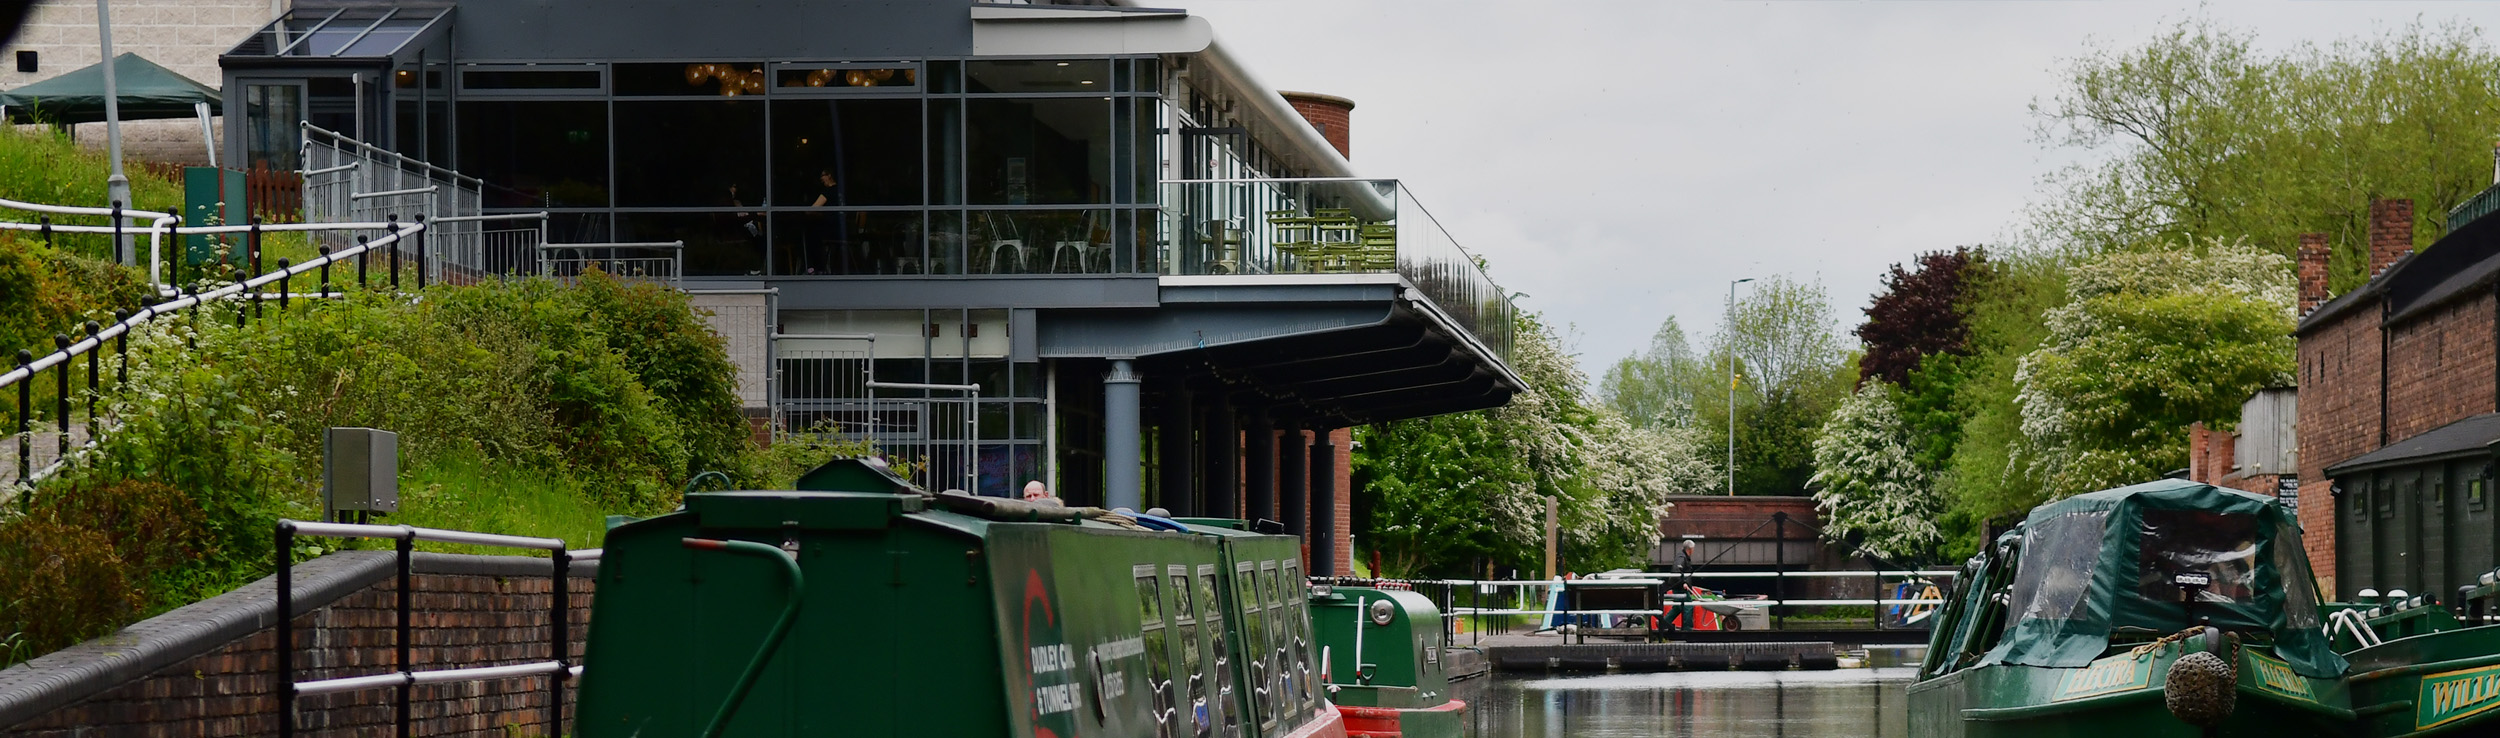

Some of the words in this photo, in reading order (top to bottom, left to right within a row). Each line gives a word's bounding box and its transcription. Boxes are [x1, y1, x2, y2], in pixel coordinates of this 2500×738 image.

[1031, 645, 1058, 673] DUDLEY
[2065, 660, 2136, 694] ELECTRA
[2259, 660, 2309, 696] ELECTRA
[1036, 687, 1044, 715] &
[1042, 684, 1072, 714] TUNNEL
